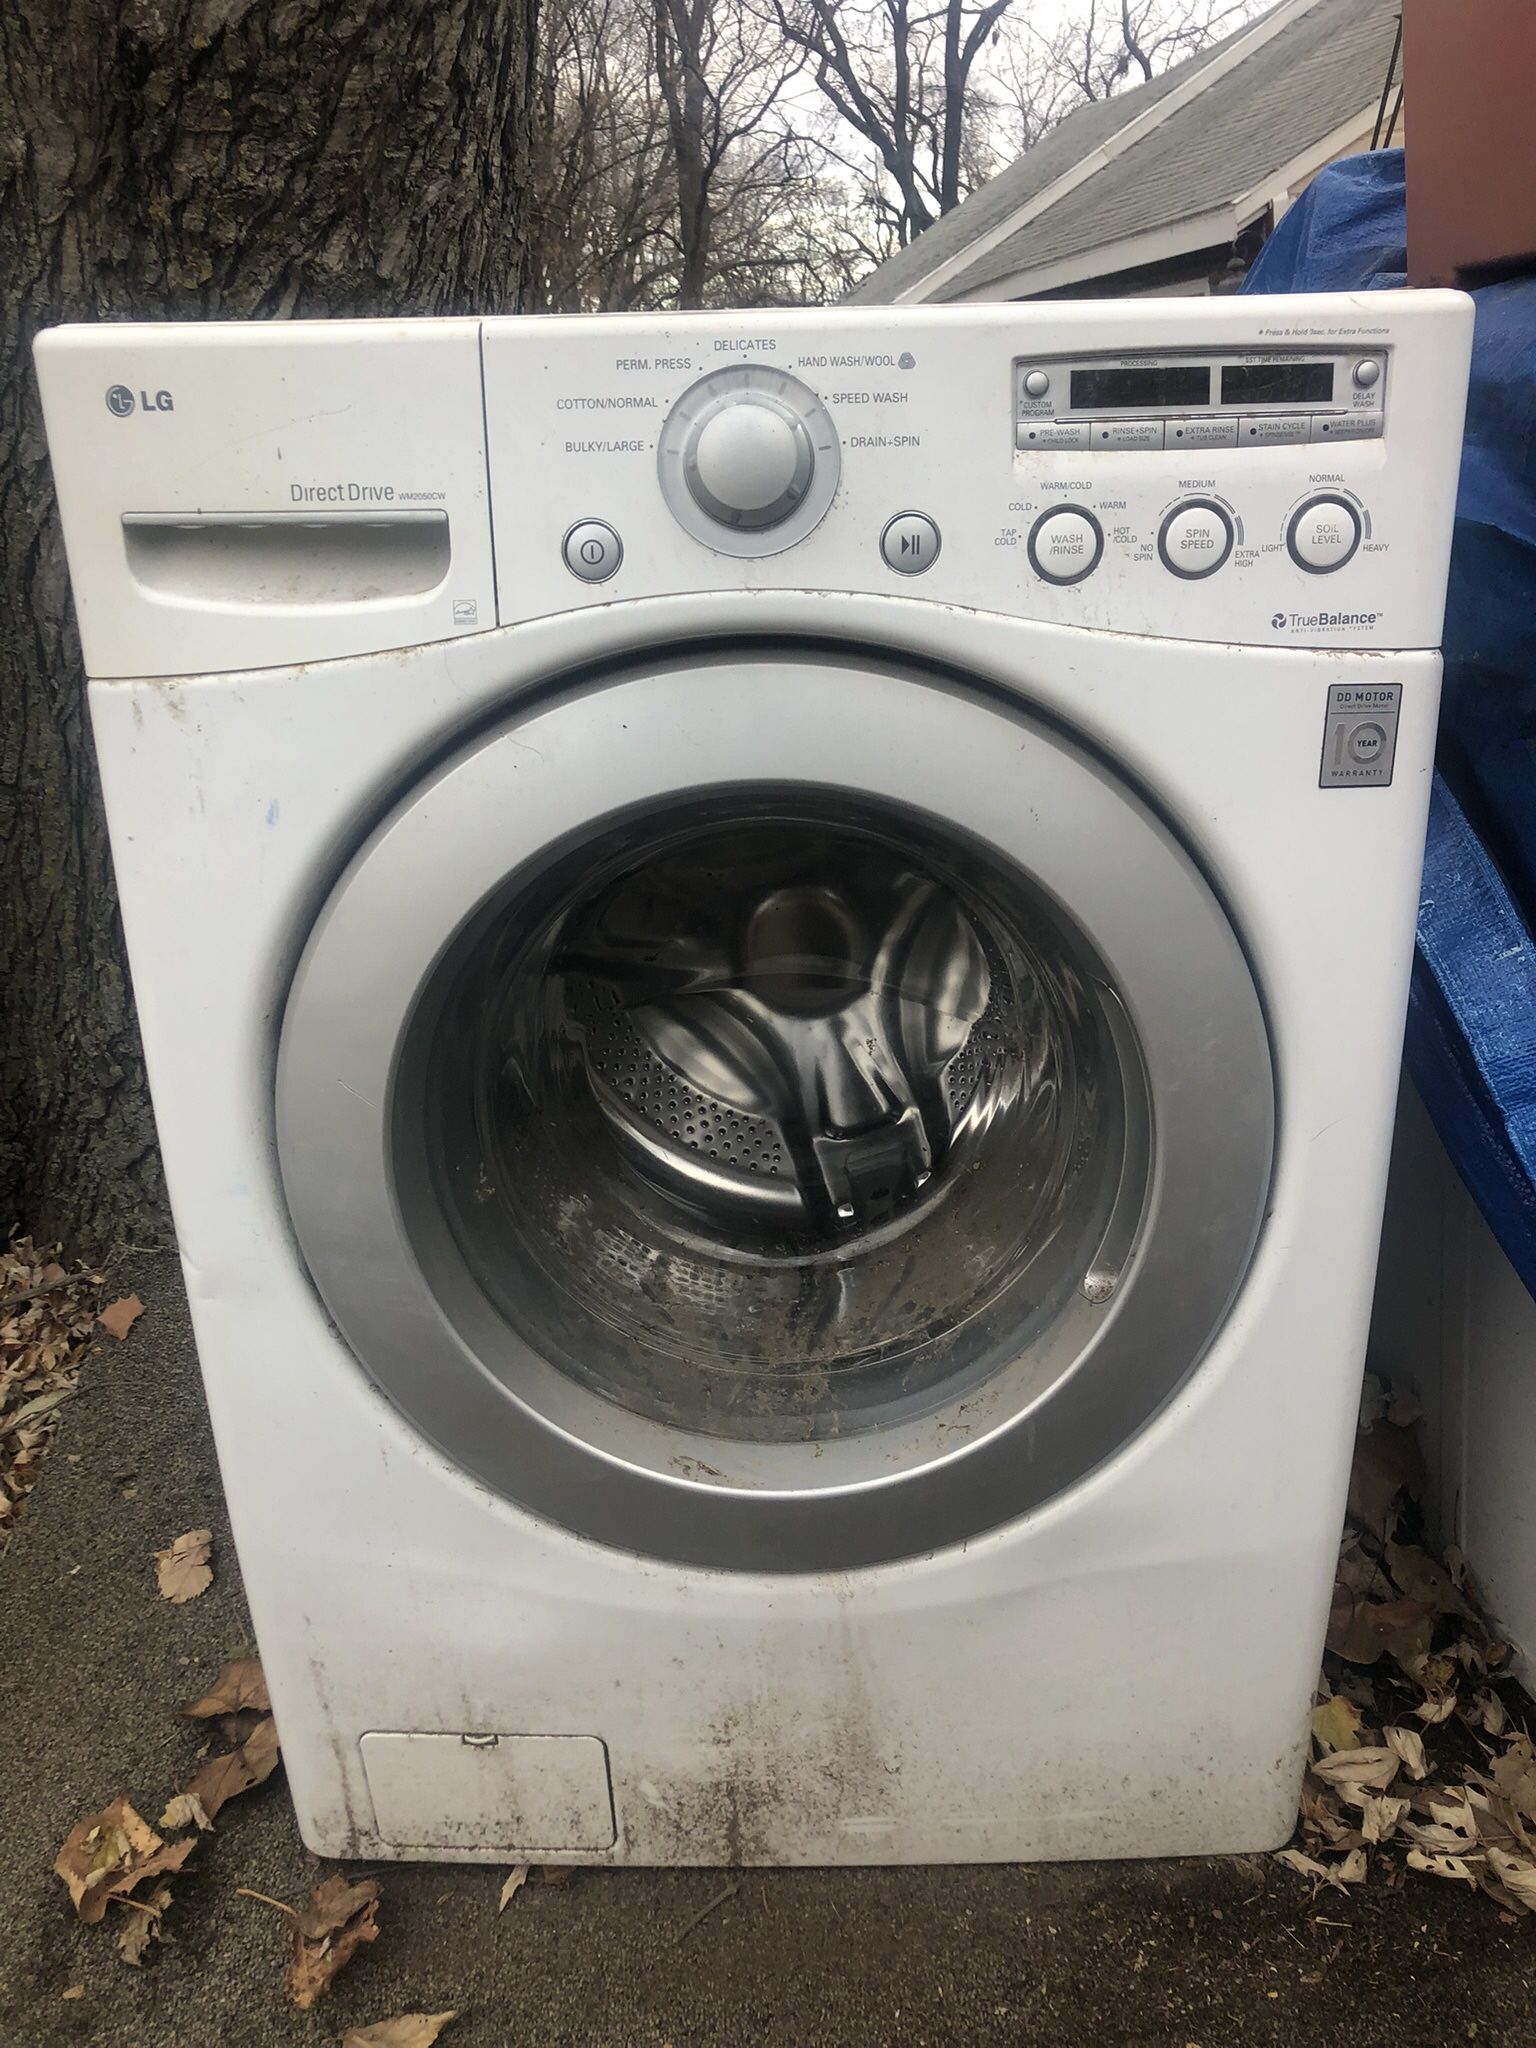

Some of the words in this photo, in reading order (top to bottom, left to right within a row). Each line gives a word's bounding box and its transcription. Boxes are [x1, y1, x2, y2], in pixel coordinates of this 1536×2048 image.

[714, 339, 777, 351] DELICATES
[616, 358, 652, 371] PERM.
[654, 358, 691, 371] PRESS
[798, 356, 827, 368] HAND
[829, 355, 896, 367] WASH/WOOL
[1120, 359, 1158, 367] PROCESSING
[140, 390, 174, 411] LG
[832, 392, 869, 404] SPEED
[872, 392, 908, 403] WASH
[1353, 392, 1375, 401] DELAY
[556, 397, 658, 410] COTTON/NORMAL
[1023, 401, 1053, 409] CUSTOM
[1353, 400, 1375, 408] WASH
[1022, 409, 1055, 417] PROGRAM
[1258, 423, 1280, 431] STAIN
[1282, 422, 1305, 430] CYCLE
[1329, 420, 1355, 428] WATER
[1356, 419, 1376, 427] PLUS
[1040, 428, 1081, 436] PRE-WASH
[1112, 427, 1158, 435] RINSE+SPIN
[565, 440, 645, 453] BULKY/LARGE
[850, 436, 920, 449] DRAIN+SPIN
[1309, 474, 1345, 483] NORMAL
[1040, 481, 1092, 490] WARM/COLD
[1178, 480, 1216, 488] MEDIUM
[290, 483, 344, 501] Direct
[348, 483, 395, 501] Drive
[1008, 503, 1032, 511] COLD
[1099, 501, 1126, 509] WARM
[1001, 528, 1017, 537] TAP
[1113, 527, 1130, 535] HOT
[1315, 524, 1339, 533] SOIL
[1185, 529, 1210, 538] SPIN
[994, 537, 1017, 546] COLD
[1051, 534, 1083, 544] WASH
[1113, 535, 1137, 543] /COLD
[1312, 535, 1342, 544] LEVEL
[1140, 544, 1153, 552] NO
[1180, 540, 1214, 549] SPEED
[1261, 544, 1284, 552] LIGHT
[1362, 544, 1390, 552] HEAVY
[1049, 545, 1084, 555] /RINSE
[1235, 550, 1260, 559] EXTRA
[1133, 553, 1153, 561] SPIN
[1235, 559, 1253, 567] HIGH
[1337, 692, 1351, 702] DD
[1355, 692, 1394, 702] MOTOR
[1357, 739, 1378, 748] YEAR
[1331, 769, 1384, 777] WARRANTY
